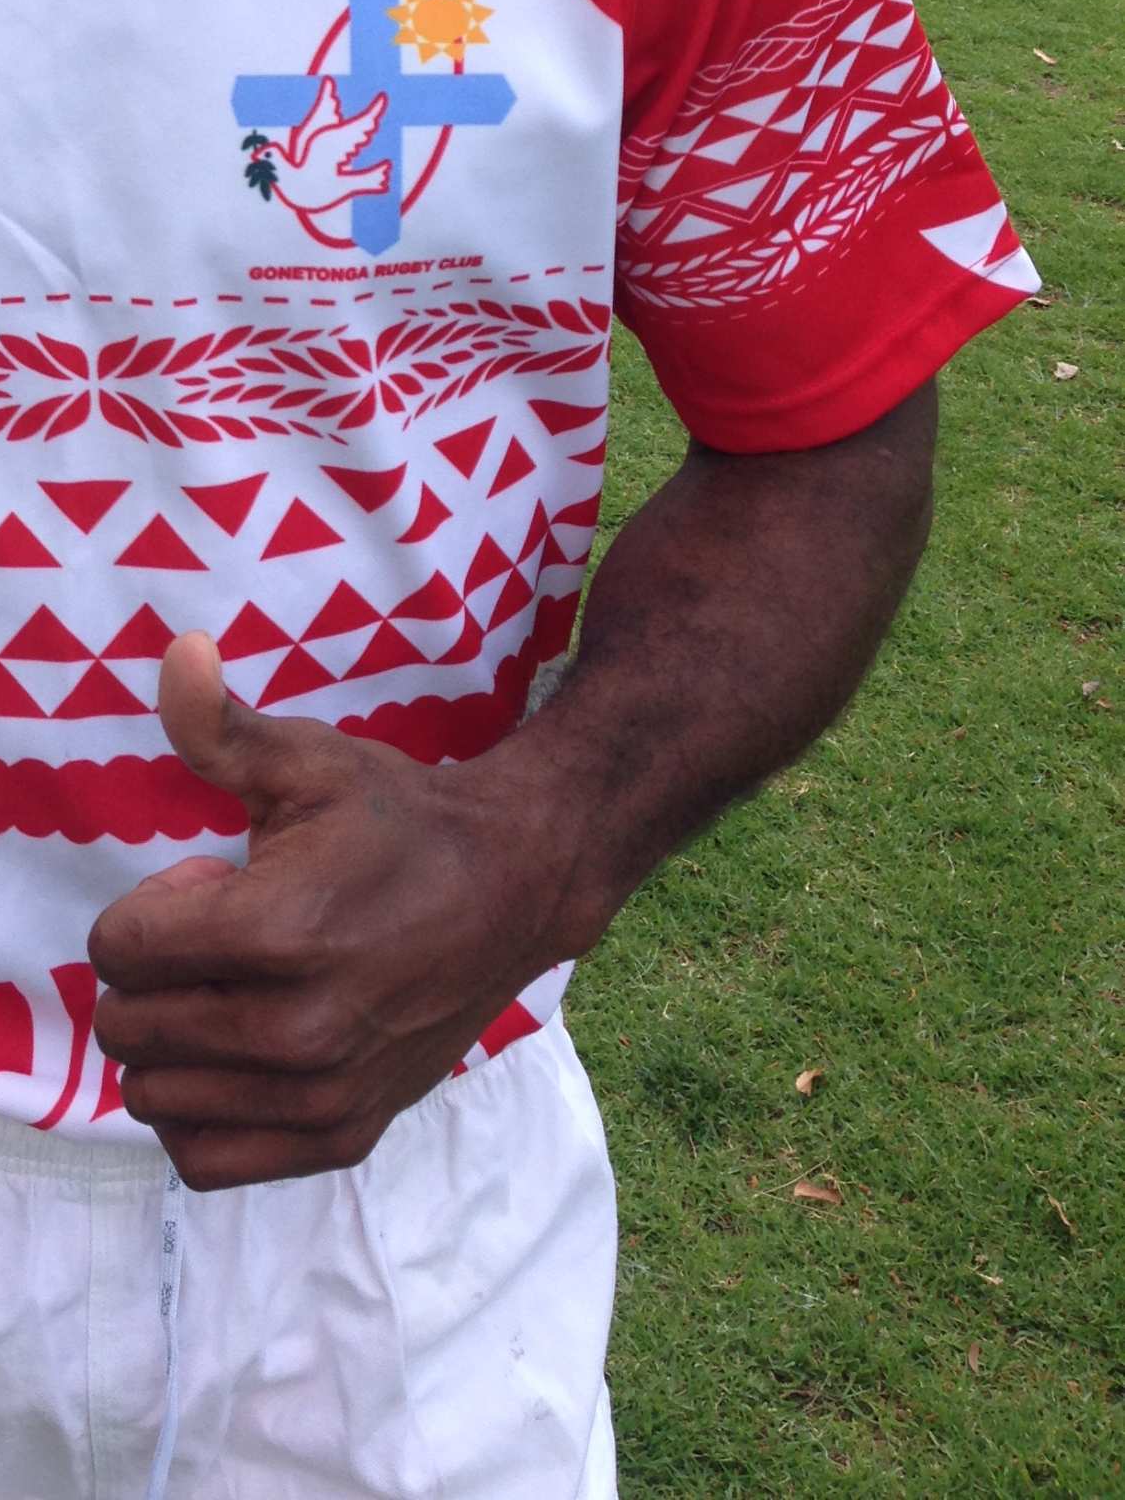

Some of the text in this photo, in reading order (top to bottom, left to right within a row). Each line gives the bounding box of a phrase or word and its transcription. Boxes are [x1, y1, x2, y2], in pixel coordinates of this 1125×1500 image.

[249, 256, 483, 281] GONETONGA RUGBY CLUB
